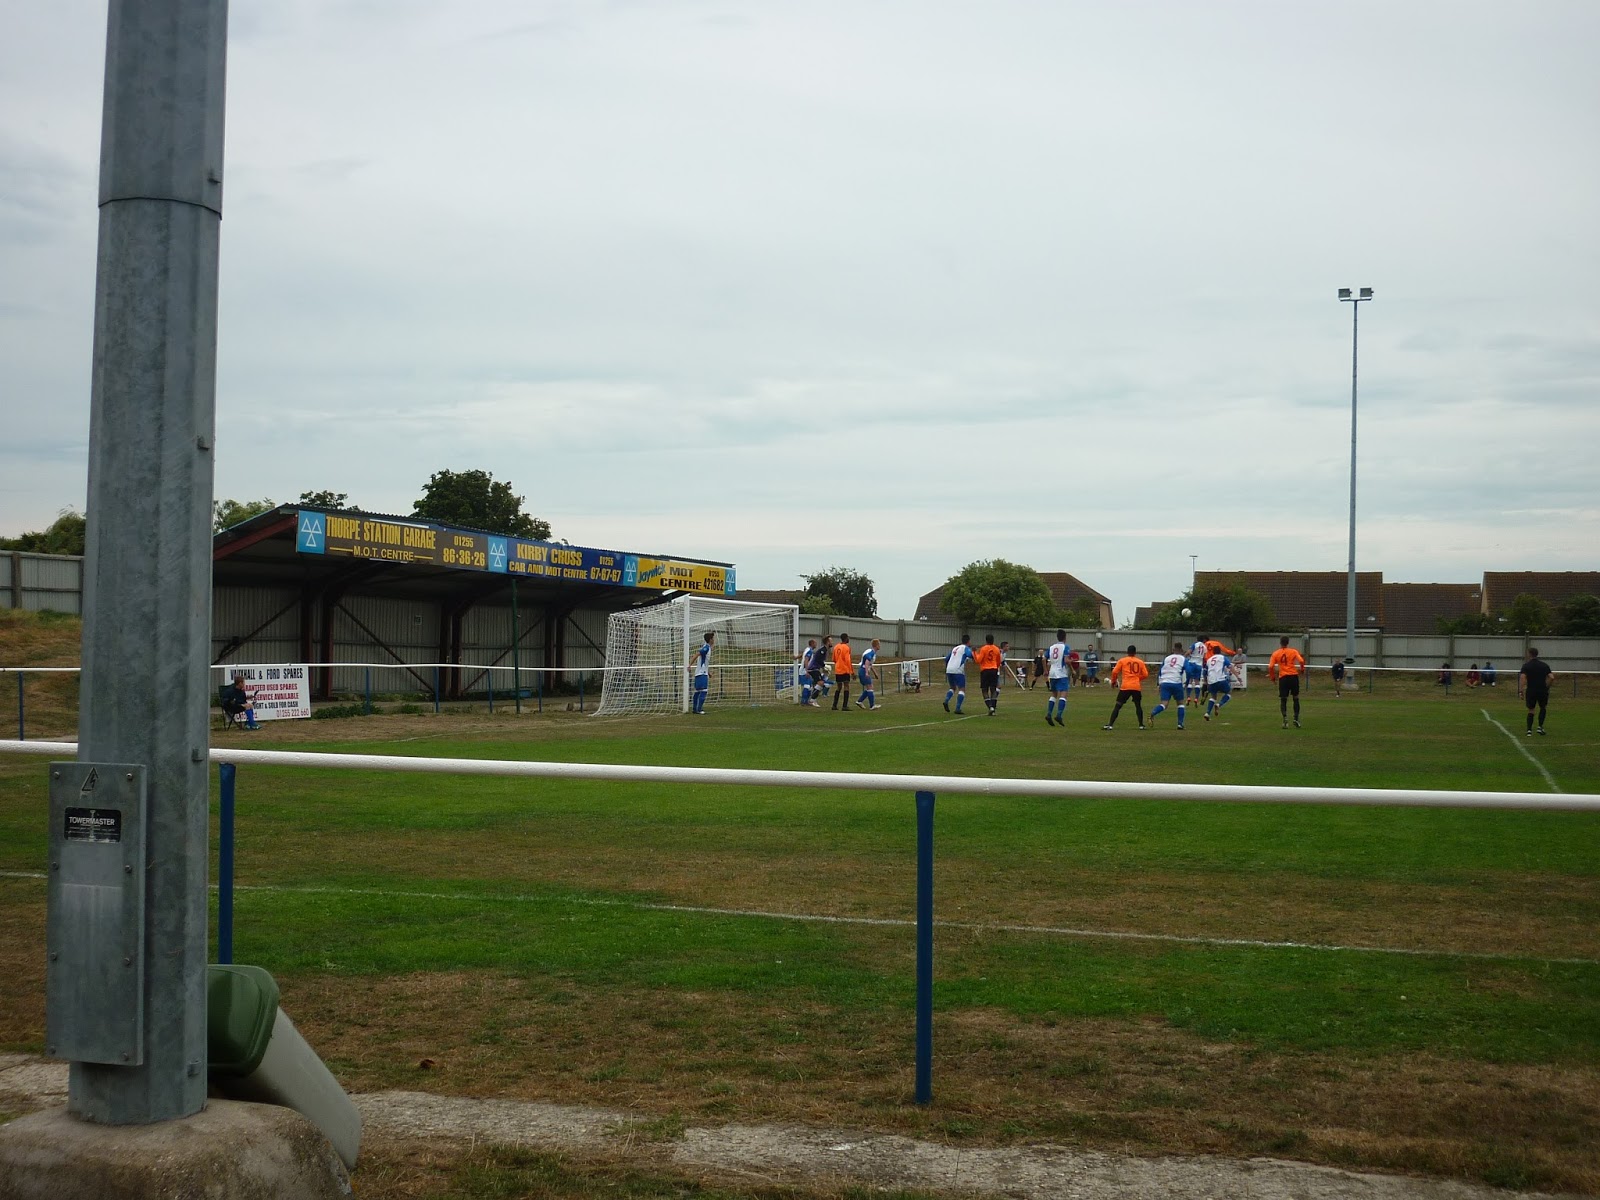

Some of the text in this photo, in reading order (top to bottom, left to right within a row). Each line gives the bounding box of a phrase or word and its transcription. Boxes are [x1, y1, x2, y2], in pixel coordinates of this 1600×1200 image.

[326, 516, 436, 549] THORPE STATION GARAGE
[454, 536, 474, 548] 01255
[354, 546, 414, 561] M.O.T. CENTRE
[517, 544, 583, 567] KIRBY CROSS
[600, 556, 614, 566] 01255
[509, 561, 588, 580] CAR AND MOT CENTRE
[670, 567, 694, 578] MOT
[660, 578, 702, 590] CENTRE
[704, 578, 724, 591] 421682
[988, 650, 994, 662] 5
[1053, 648, 1059, 660] 8
[1281, 654, 1287, 666] 4
[1171, 657, 1178, 667] 9
[1211, 657, 1217, 666] 5
[259, 671, 263, 680] &
[267, 669, 280, 680] FORD
[283, 668, 303, 679] SPARES
[1127, 662, 1140, 674] 10
[291, 709, 300, 717] 222
[69, 817, 115, 826] TOWERMASTER
